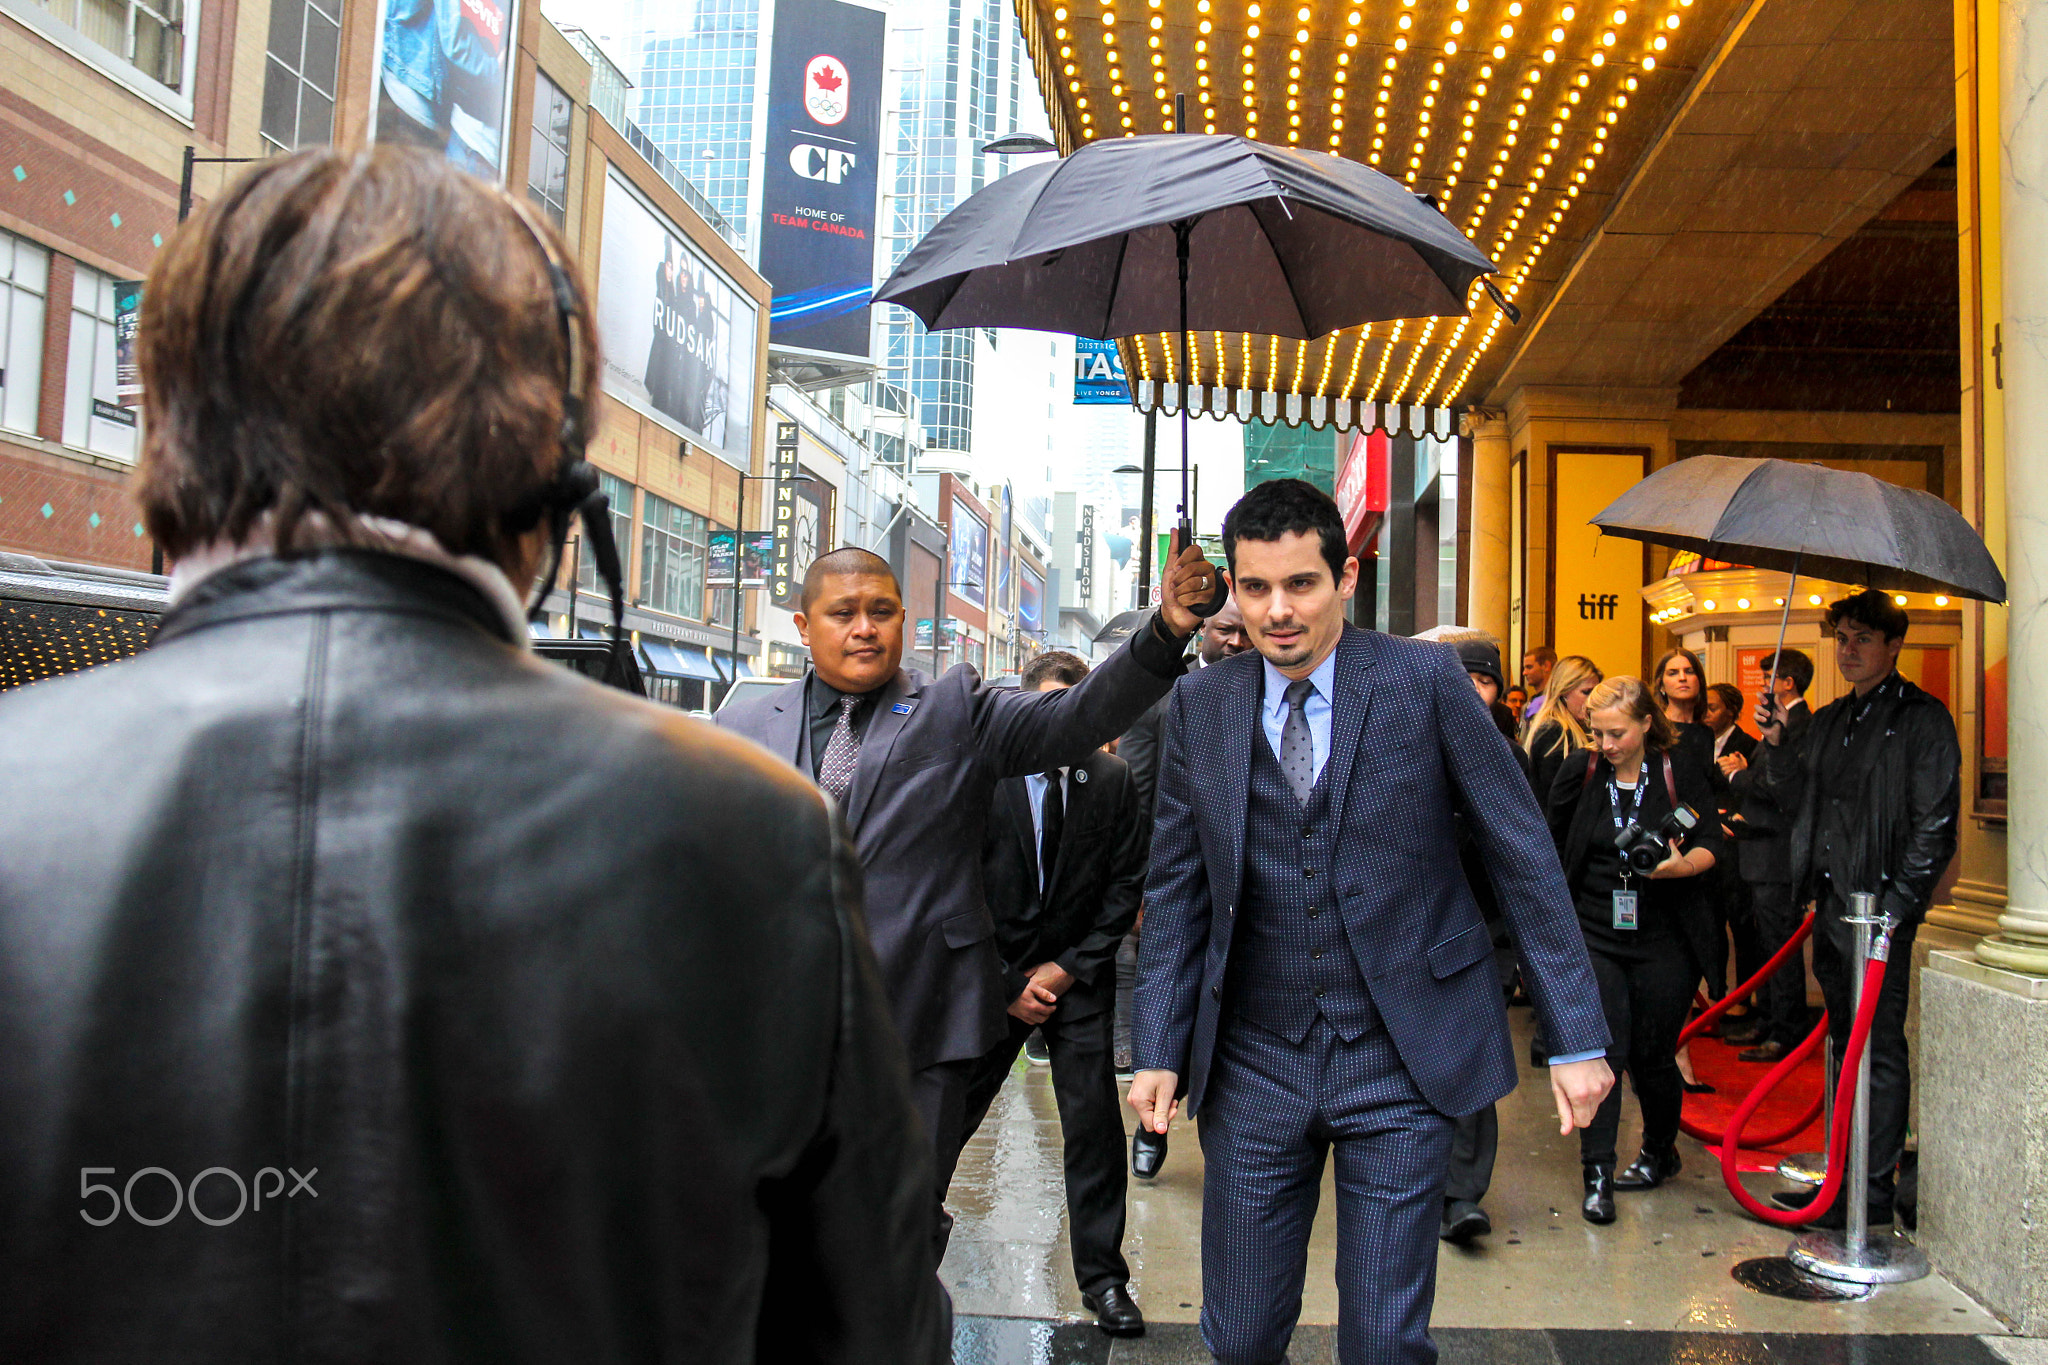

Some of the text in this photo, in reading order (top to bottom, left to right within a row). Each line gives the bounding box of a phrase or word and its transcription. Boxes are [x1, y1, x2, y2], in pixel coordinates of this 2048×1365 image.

[789, 144, 855, 184] CF
[771, 213, 865, 240] TEAM CANADA
[795, 206, 845, 222] HOME OF
[654, 297, 715, 371] RUDSAK
[1078, 342, 1116, 350] DISTRIC
[1081, 507, 1093, 596] NORDSTROM
[1577, 593, 1619, 620] tiff
